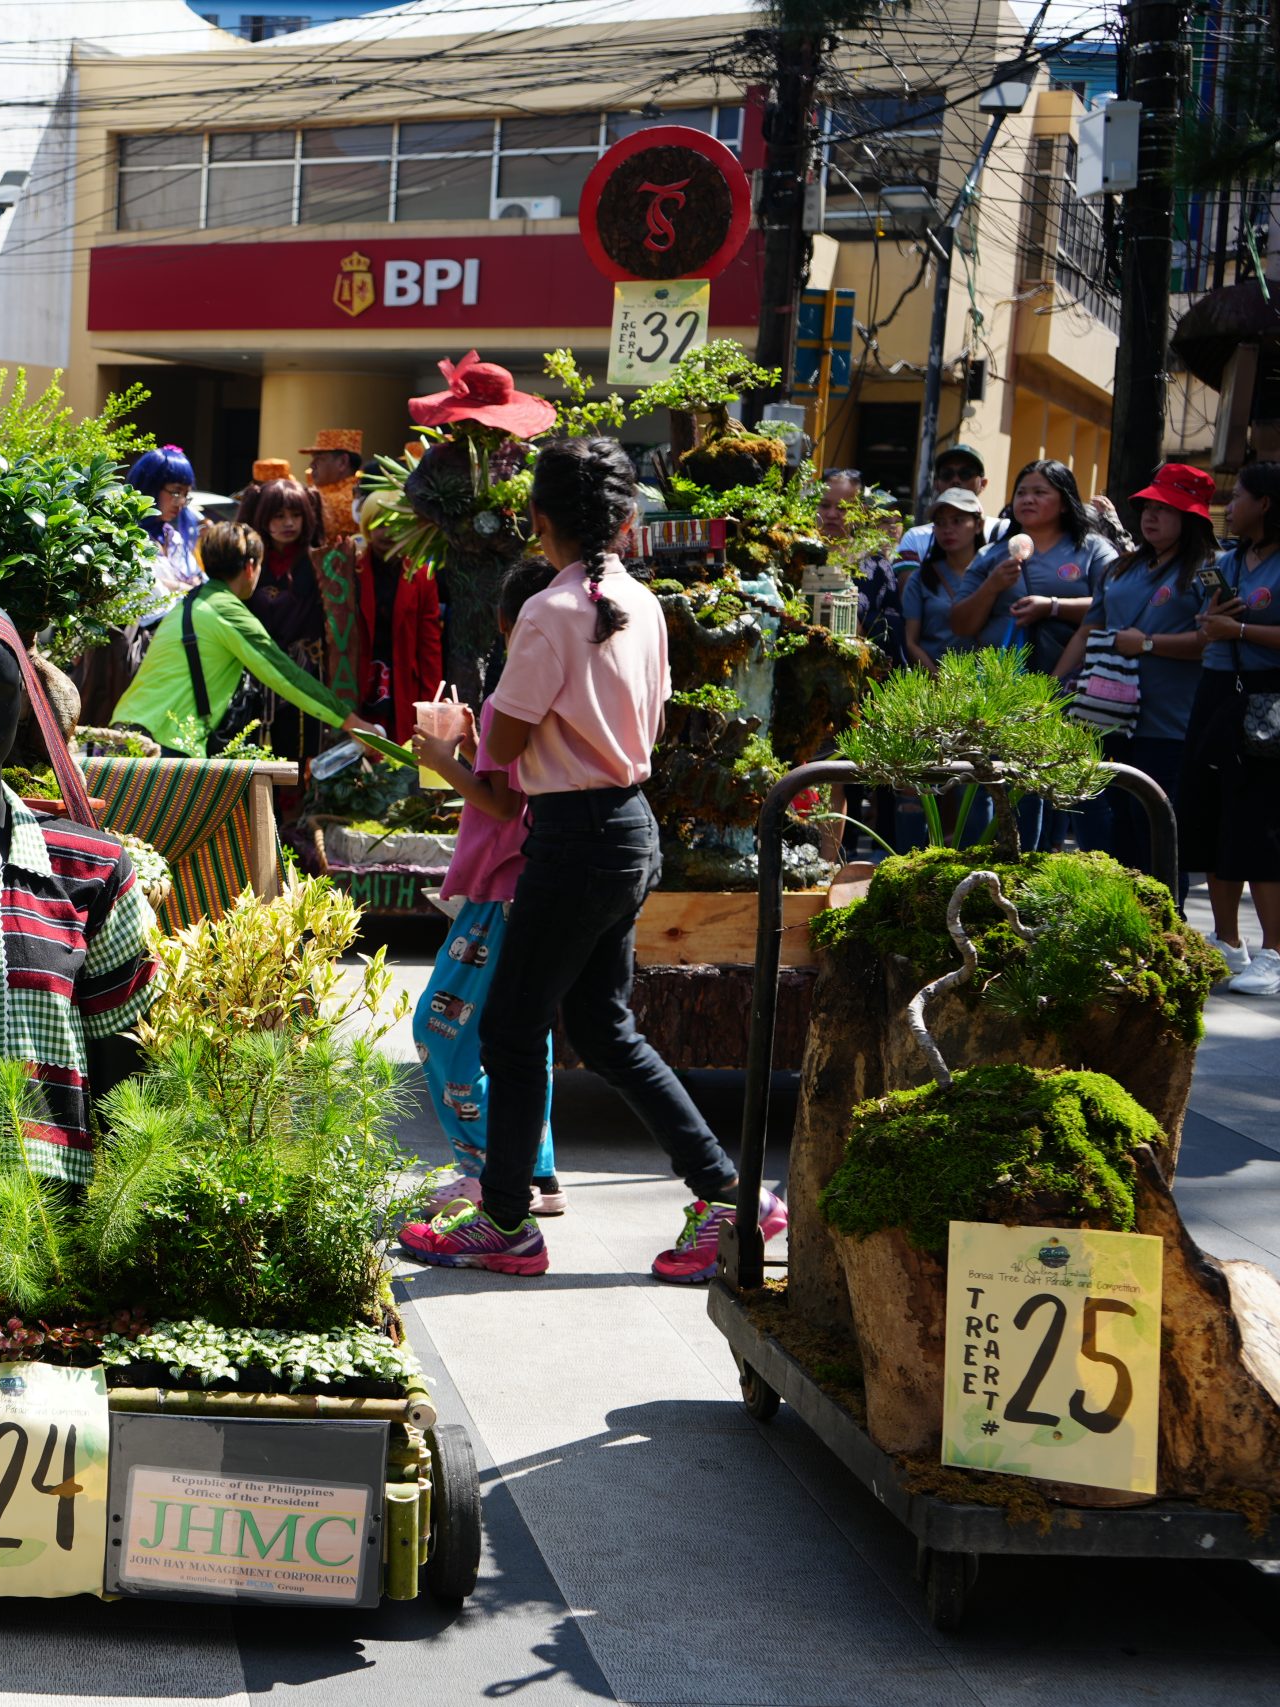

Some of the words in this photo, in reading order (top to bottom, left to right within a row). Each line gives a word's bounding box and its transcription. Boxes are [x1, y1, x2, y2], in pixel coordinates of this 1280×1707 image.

[384, 258, 480, 307] BPI
[618, 312, 631, 353] TREE
[637, 310, 700, 364] 32
[323, 550, 359, 711] SVA
[969, 1270, 994, 1281] Bonsai
[999, 1272, 1020, 1283] Tree
[1023, 1275, 1042, 1286] Cart
[1045, 1276, 1073, 1287] Parade
[1077, 1280, 1093, 1289] and
[1096, 1281, 1141, 1294] Competition
[963, 1287, 985, 1395] TREE
[983, 1313, 1000, 1411] CART
[1003, 1293, 1137, 1434] 25
[172, 1475, 225, 1488] Republic
[229, 1481, 243, 1490] of
[245, 1482, 264, 1492] the
[268, 1484, 335, 1498] Philippines
[184, 1487, 222, 1499] Office
[225, 1491, 238, 1500] of
[240, 1493, 260, 1503] the
[263, 1495, 320, 1508] President
[139, 1500, 357, 1567] JHMC
[130, 1555, 160, 1566] JOHN
[164, 1559, 188, 1569] HAY
[189, 1561, 272, 1578] MANAGEMENT
[274, 1570, 357, 1585] CORPORATION
[229, 1578, 244, 1586] The
[277, 1583, 305, 1592] Group
